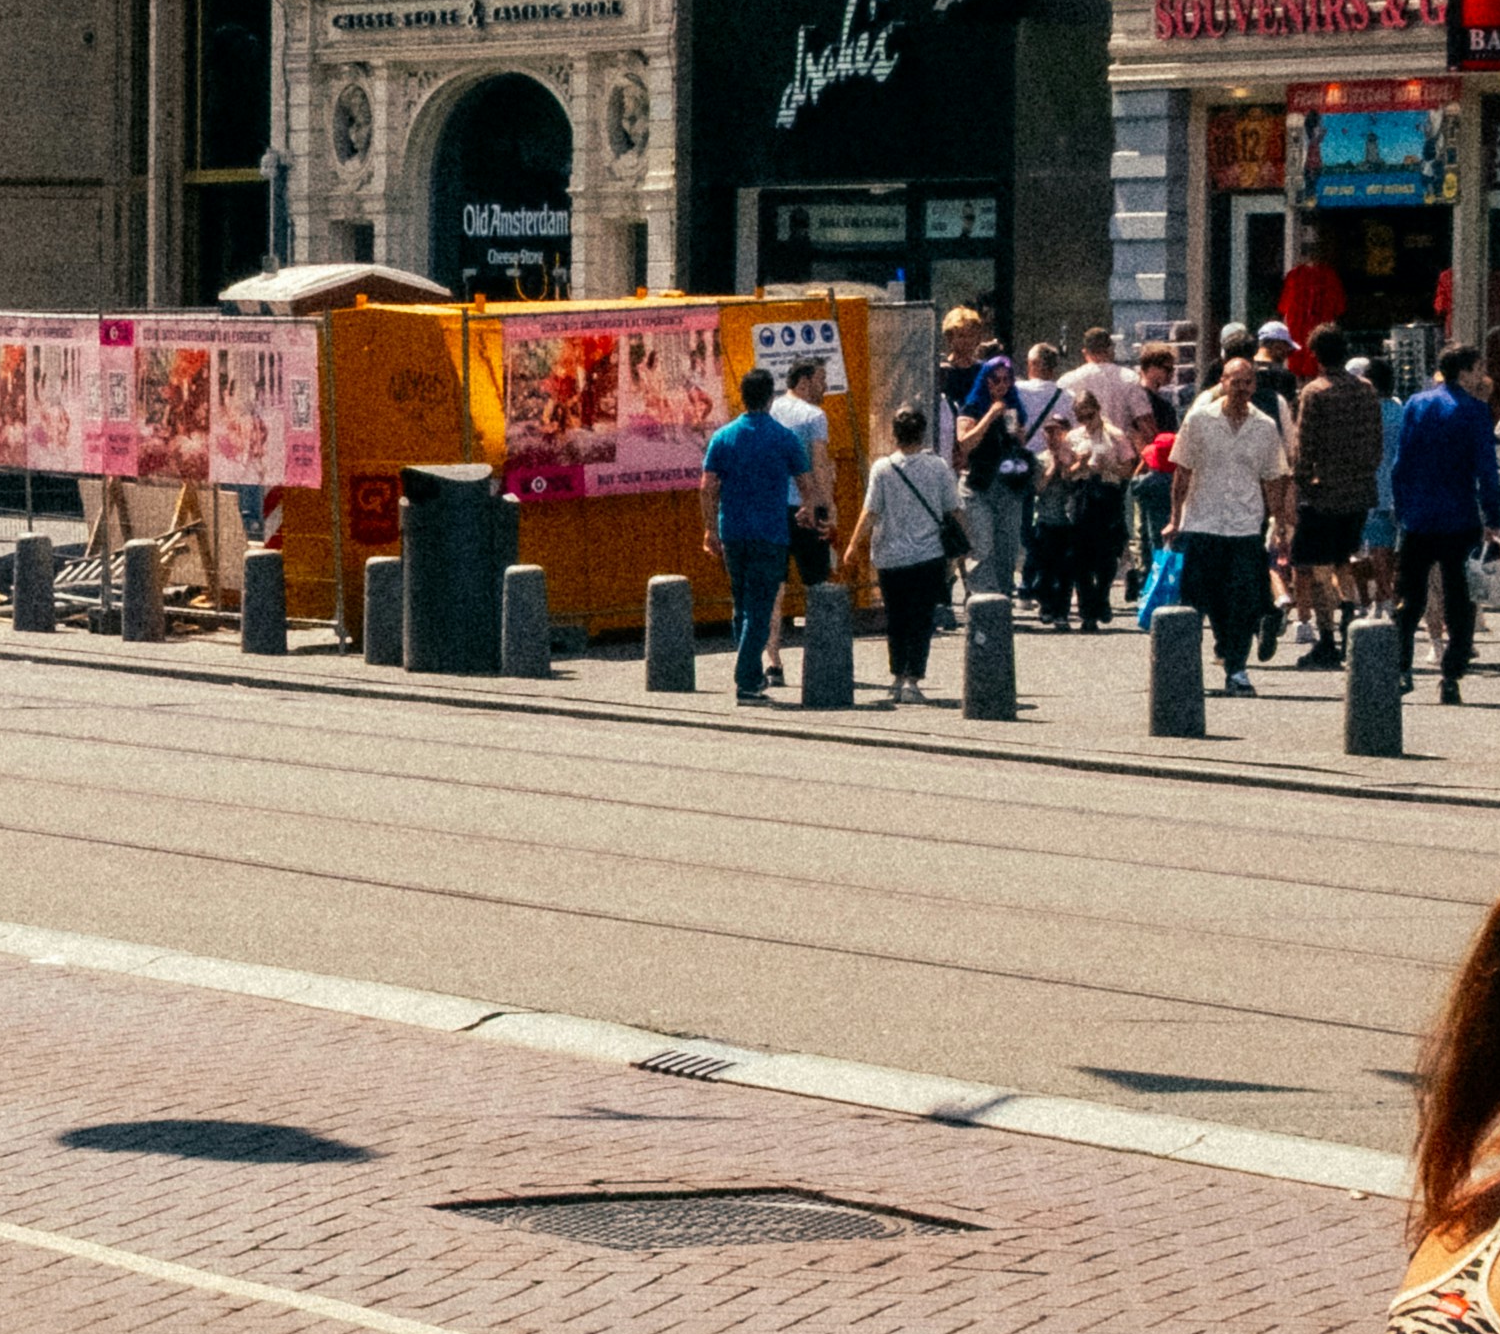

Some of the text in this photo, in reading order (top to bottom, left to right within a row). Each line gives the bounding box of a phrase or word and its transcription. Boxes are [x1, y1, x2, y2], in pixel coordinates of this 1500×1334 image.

[463, 203, 569, 236] Old Amsterdam
[487, 248, 545, 265] Cheese Store
